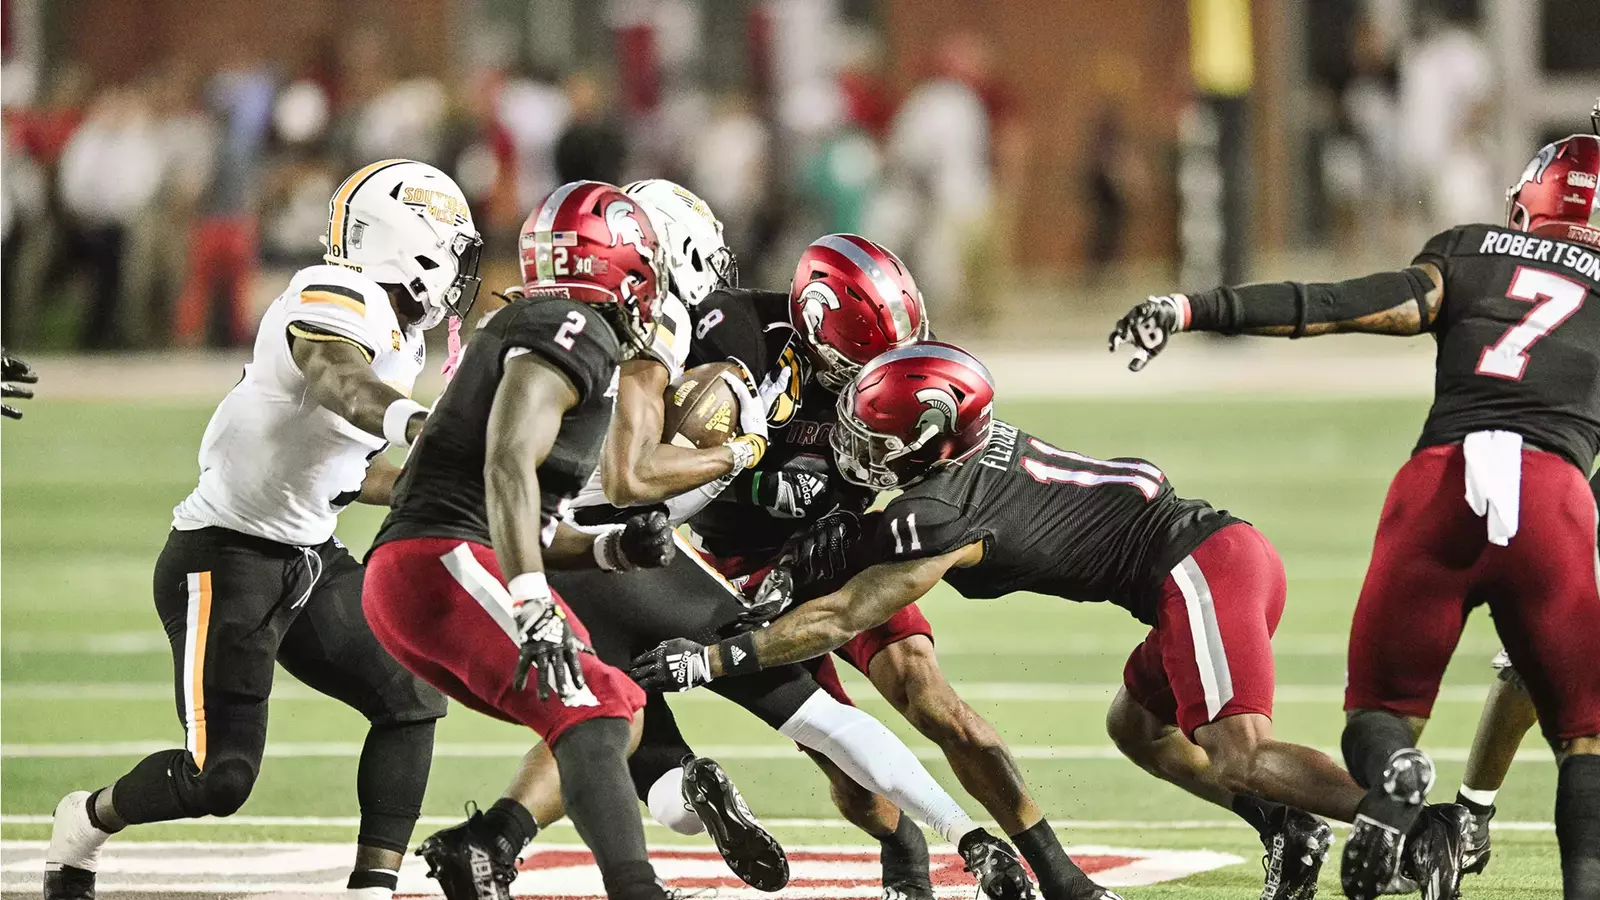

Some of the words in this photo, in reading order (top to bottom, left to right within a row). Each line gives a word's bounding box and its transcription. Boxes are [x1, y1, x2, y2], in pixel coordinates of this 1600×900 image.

[553, 246, 569, 276] 2
[576, 256, 593, 274] 40
[1479, 231, 1600, 282] ROBERTSON
[553, 310, 587, 351] 2
[696, 308, 725, 340] 8
[1474, 264, 1592, 382] 7
[1020, 436, 1165, 502] 11
[796, 473, 812, 506] adidas
[890, 512, 922, 555] 11
[677, 650, 692, 684] adidas
